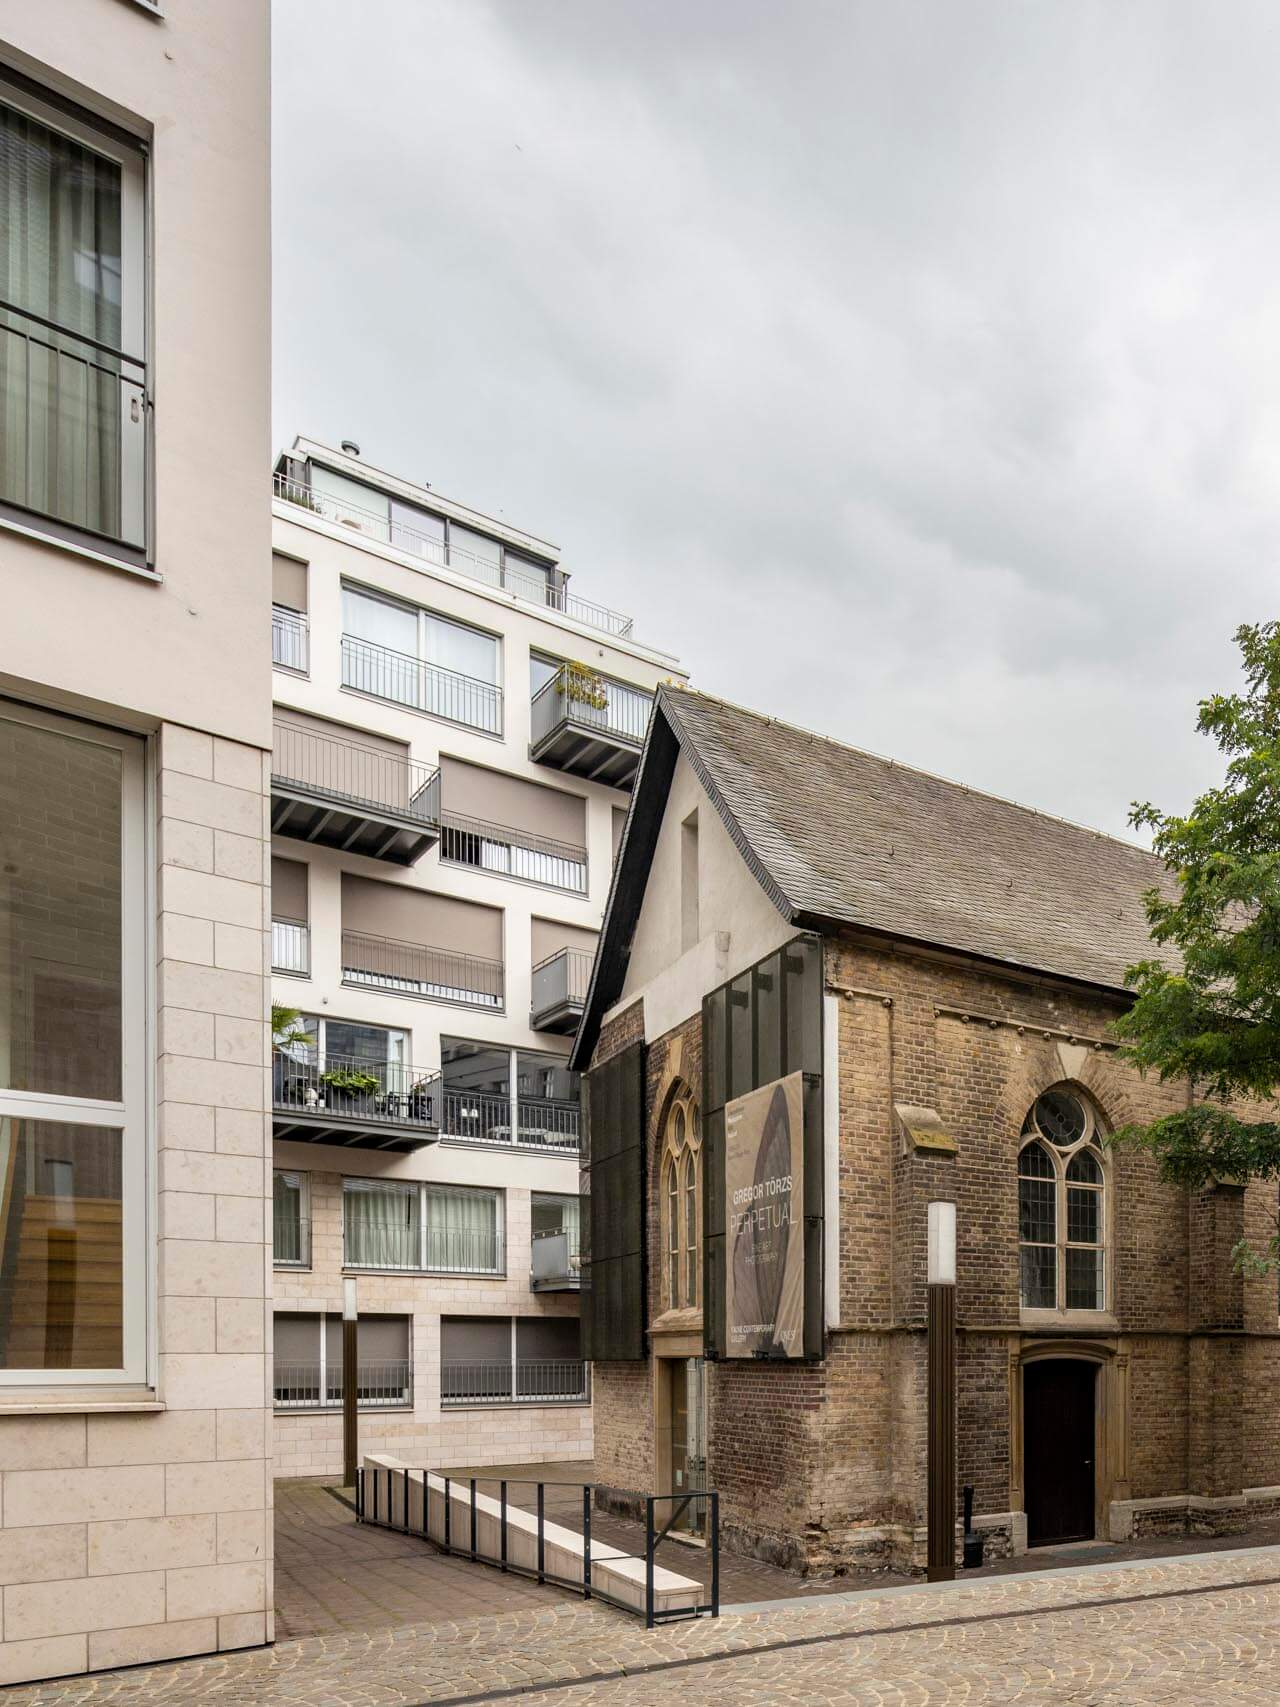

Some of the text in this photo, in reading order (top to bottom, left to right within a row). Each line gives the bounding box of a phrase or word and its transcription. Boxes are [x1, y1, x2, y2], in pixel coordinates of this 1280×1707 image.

[733, 1176, 793, 1205] GREGOR TÖRZS
[730, 1201, 798, 1235] PERPETUAL
